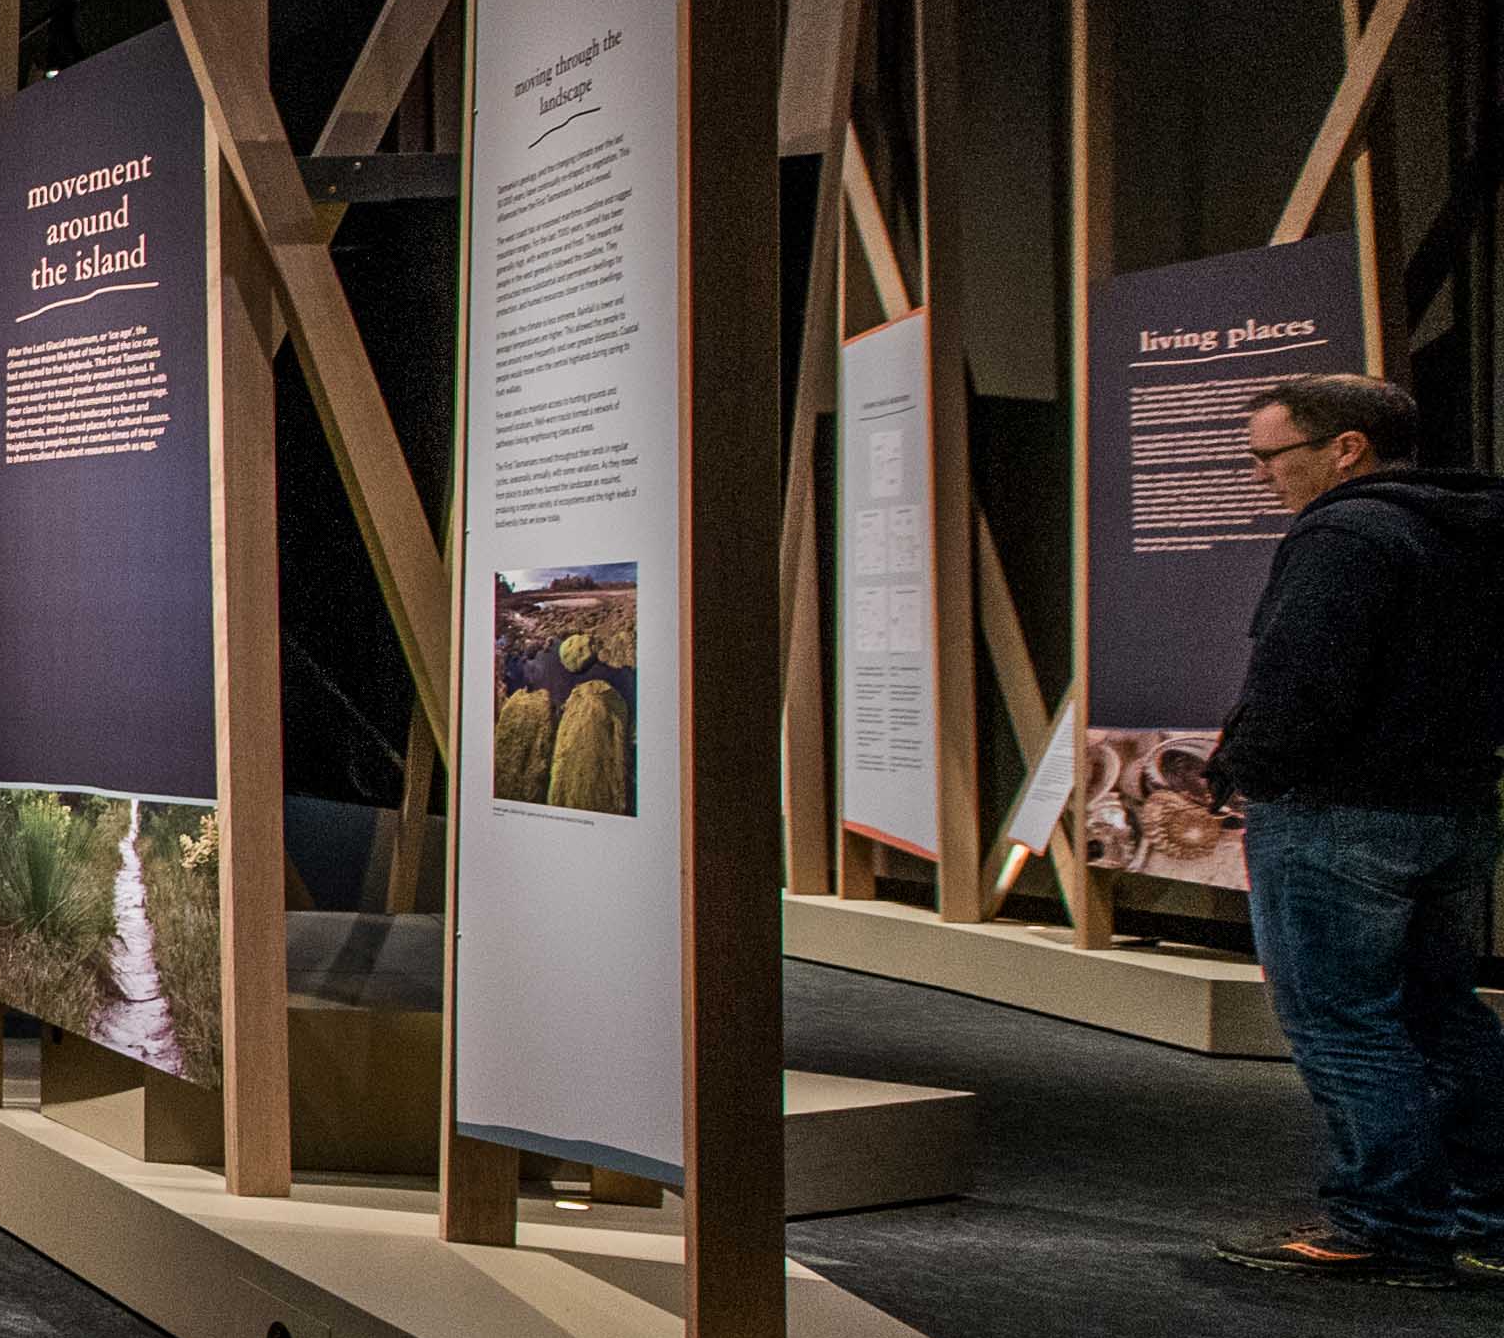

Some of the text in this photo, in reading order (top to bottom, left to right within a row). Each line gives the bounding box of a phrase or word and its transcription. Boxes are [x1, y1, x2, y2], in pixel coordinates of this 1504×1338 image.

[514, 29, 622, 98] moving through the
[539, 78, 593, 116] landscape
[27, 154, 153, 210] movement
[46, 194, 130, 246] around
[32, 234, 147, 292] the island
[1140, 318, 1317, 352] living places
